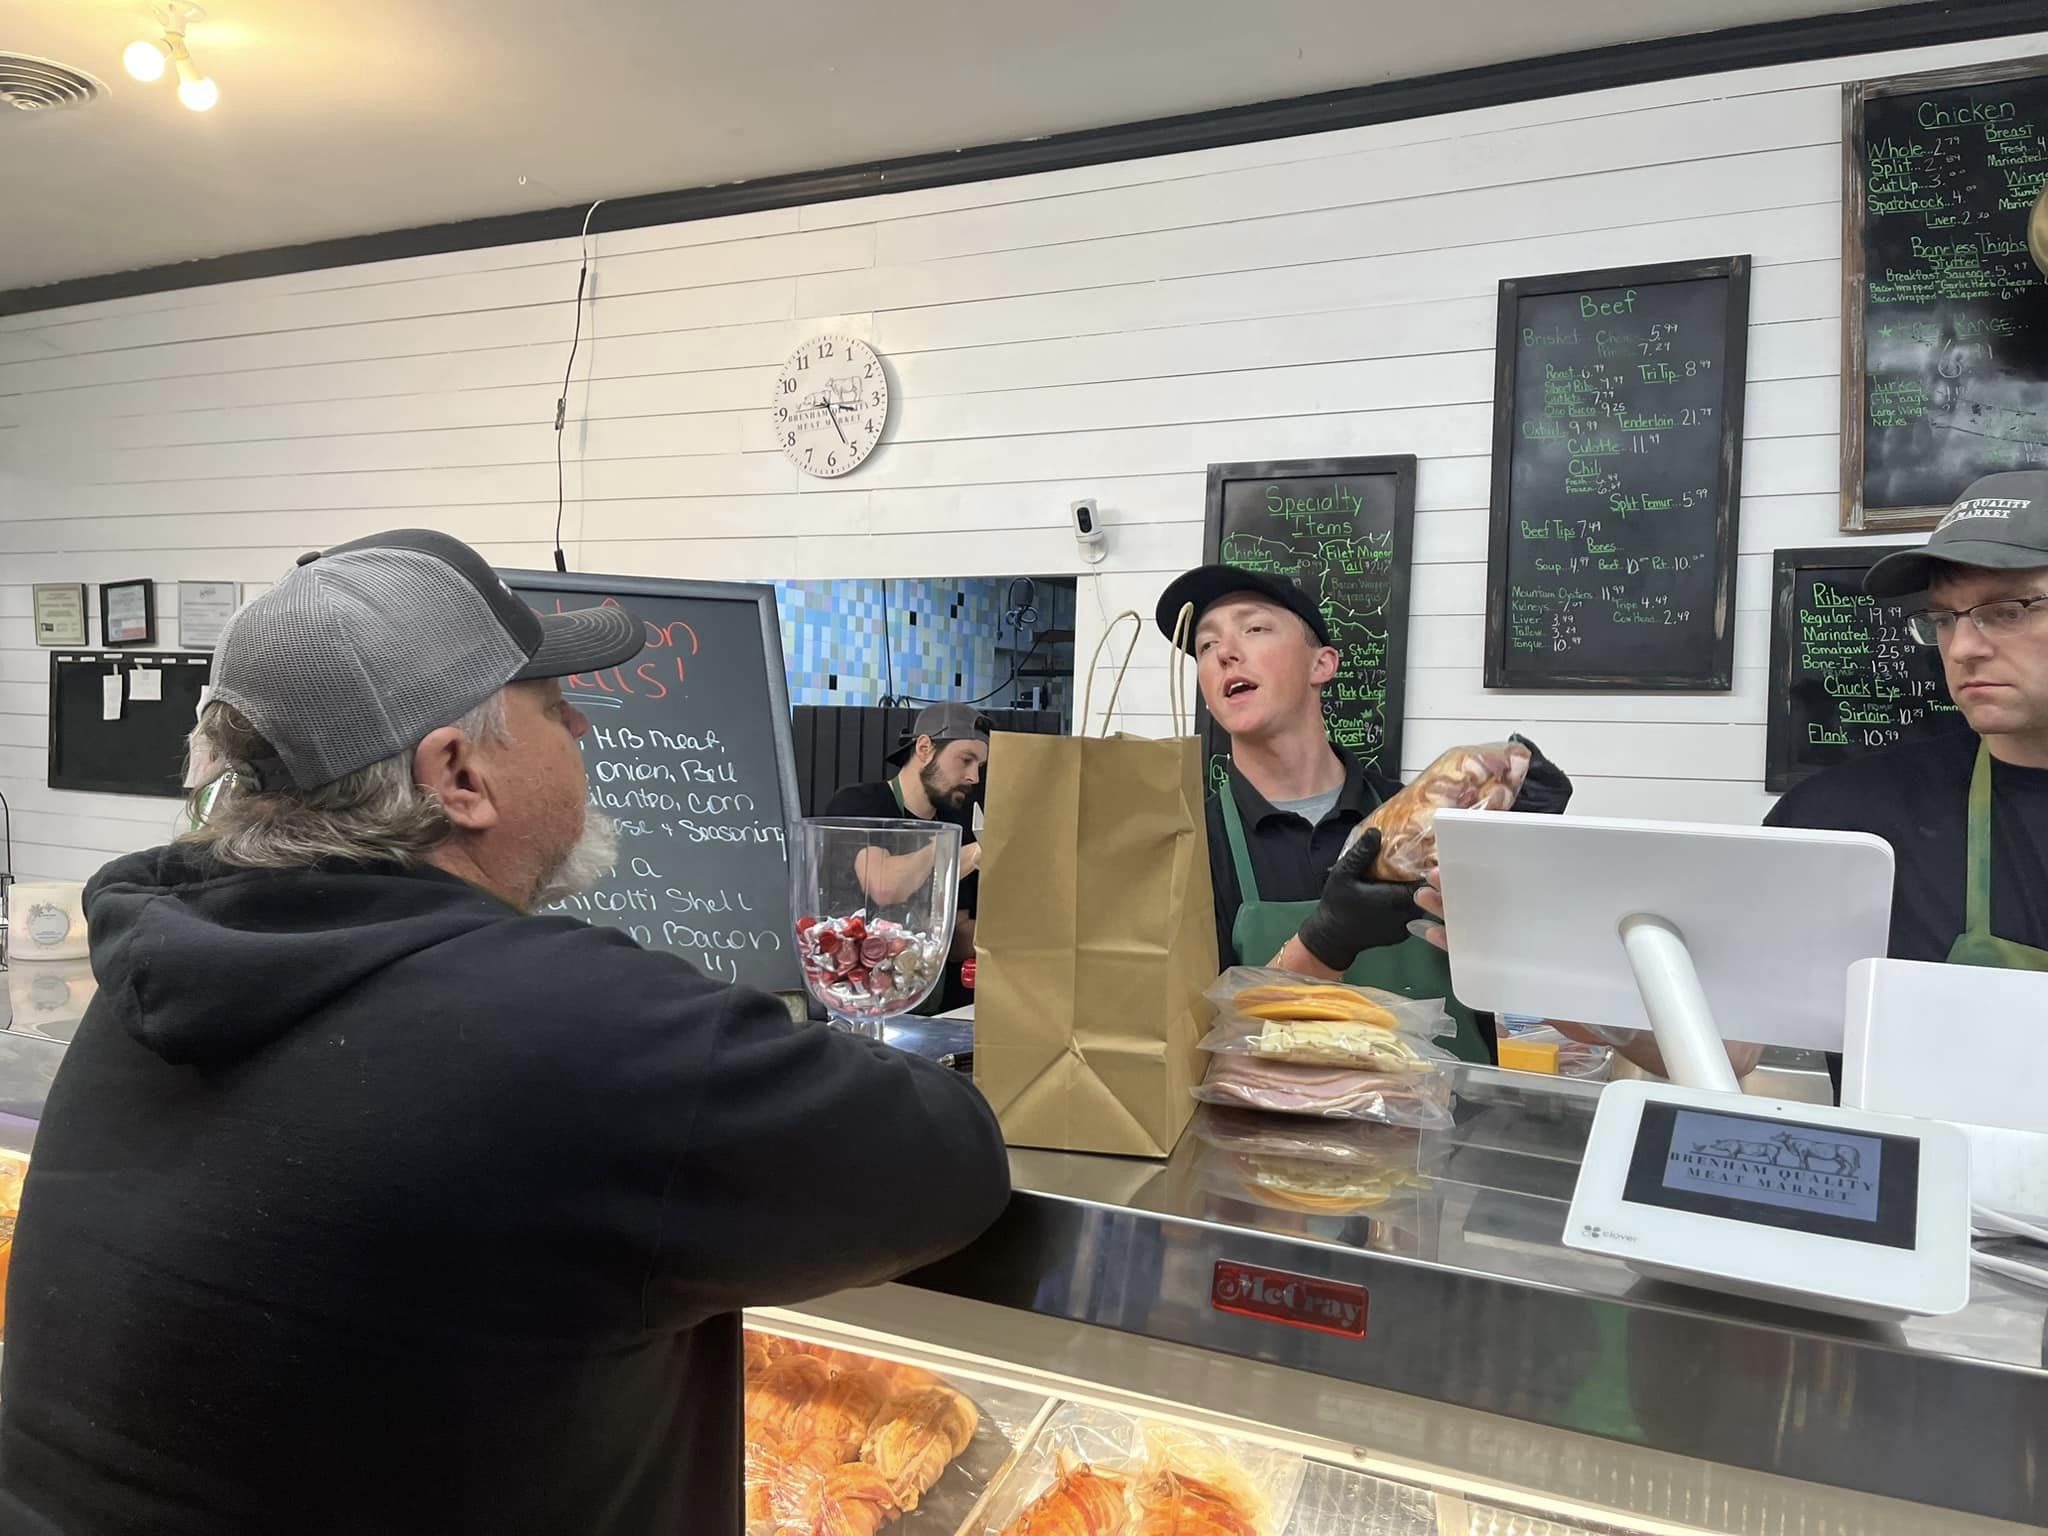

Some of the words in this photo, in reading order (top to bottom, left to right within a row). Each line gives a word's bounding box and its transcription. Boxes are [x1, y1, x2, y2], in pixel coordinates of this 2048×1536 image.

[1918, 98, 2015, 129] Chicken
[1984, 122, 2034, 142] Breast
[1866, 136, 1922, 159] Whole
[1987, 150, 2042, 168] Marinated
[1871, 158, 1913, 178] Split
[2010, 187, 2040, 199] Jumb
[1867, 192, 1944, 213] Spatchcock
[1925, 211, 1956, 227] Liver
[1910, 236, 1978, 257] Boneless
[1975, 231, 2028, 256] Thighs
[1886, 267, 1940, 282] Breakfast
[1944, 267, 1990, 282] Sausage
[1580, 290, 1637, 318] Beef
[819, 342, 834, 359] 12
[846, 347, 853, 361] 1
[796, 355, 809, 371] 11
[864, 363, 874, 379] 2
[782, 377, 797, 394] 10
[872, 391, 880, 407] 3
[779, 407, 788, 423] 9
[1615, 410, 1674, 430] Tenderloin
[864, 418, 875, 433] 4
[787, 431, 796, 447] 8
[805, 448, 814, 463] 7
[850, 441, 858, 457] 5
[827, 450, 836, 467] 6
[1265, 485, 1363, 520] Specialty
[1609, 493, 1640, 518] Split
[1641, 493, 1673, 510] Femur
[1973, 498, 2032, 510] QUALITY
[1956, 509, 2011, 520] MARKET
[1291, 515, 1353, 538] Items
[1521, 520, 1549, 538] Beef
[1551, 520, 1576, 541] Tips
[1223, 541, 1273, 562] Chicken
[1326, 544, 1355, 560] Filet
[1587, 537, 1618, 553] Bones
[1535, 558, 1562, 576] Soup
[1812, 583, 1875, 616] Ribeyes
[1512, 614, 1541, 625] Liver
[1664, 610, 1690, 625] 2.49
[1800, 608, 1851, 628] Regular
[1803, 625, 1868, 641] Marinated
[1349, 643, 1385, 656] Stuffed
[1801, 642, 1870, 655] Tomahawk
[1353, 655, 1380, 667] Goat
[1801, 655, 1858, 669] Bone-In
[1337, 683, 1357, 700] Pork
[1823, 676, 1871, 697] Chuck
[1875, 679, 1900, 703] Eye
[1839, 701, 1891, 722] Sirloin
[1330, 713, 1365, 730] Crown
[592, 724, 645, 750] HB
[1334, 729, 1366, 743] Roast
[1808, 723, 1850, 744] Flank
[1863, 729, 1899, 746] 10.99
[681, 760, 739, 783] Bell
[590, 786, 682, 813] ilantro,
[688, 792, 755, 815] Corn
[679, 819, 787, 862] Seasoning
[631, 857, 662, 878] a
[547, 887, 658, 912] nicotti
[666, 888, 753, 914] Shell
[663, 920, 781, 951] Bacon
[1669, 1151, 1768, 1176] BRENHAM
[1777, 1167, 1874, 1192] QUALITY
[1687, 1167, 1743, 1184] MEAT
[1760, 1178, 1849, 1202] MARKET
[1602, 1230, 1639, 1243] clover
[1217, 1273, 1362, 1328] McCray
